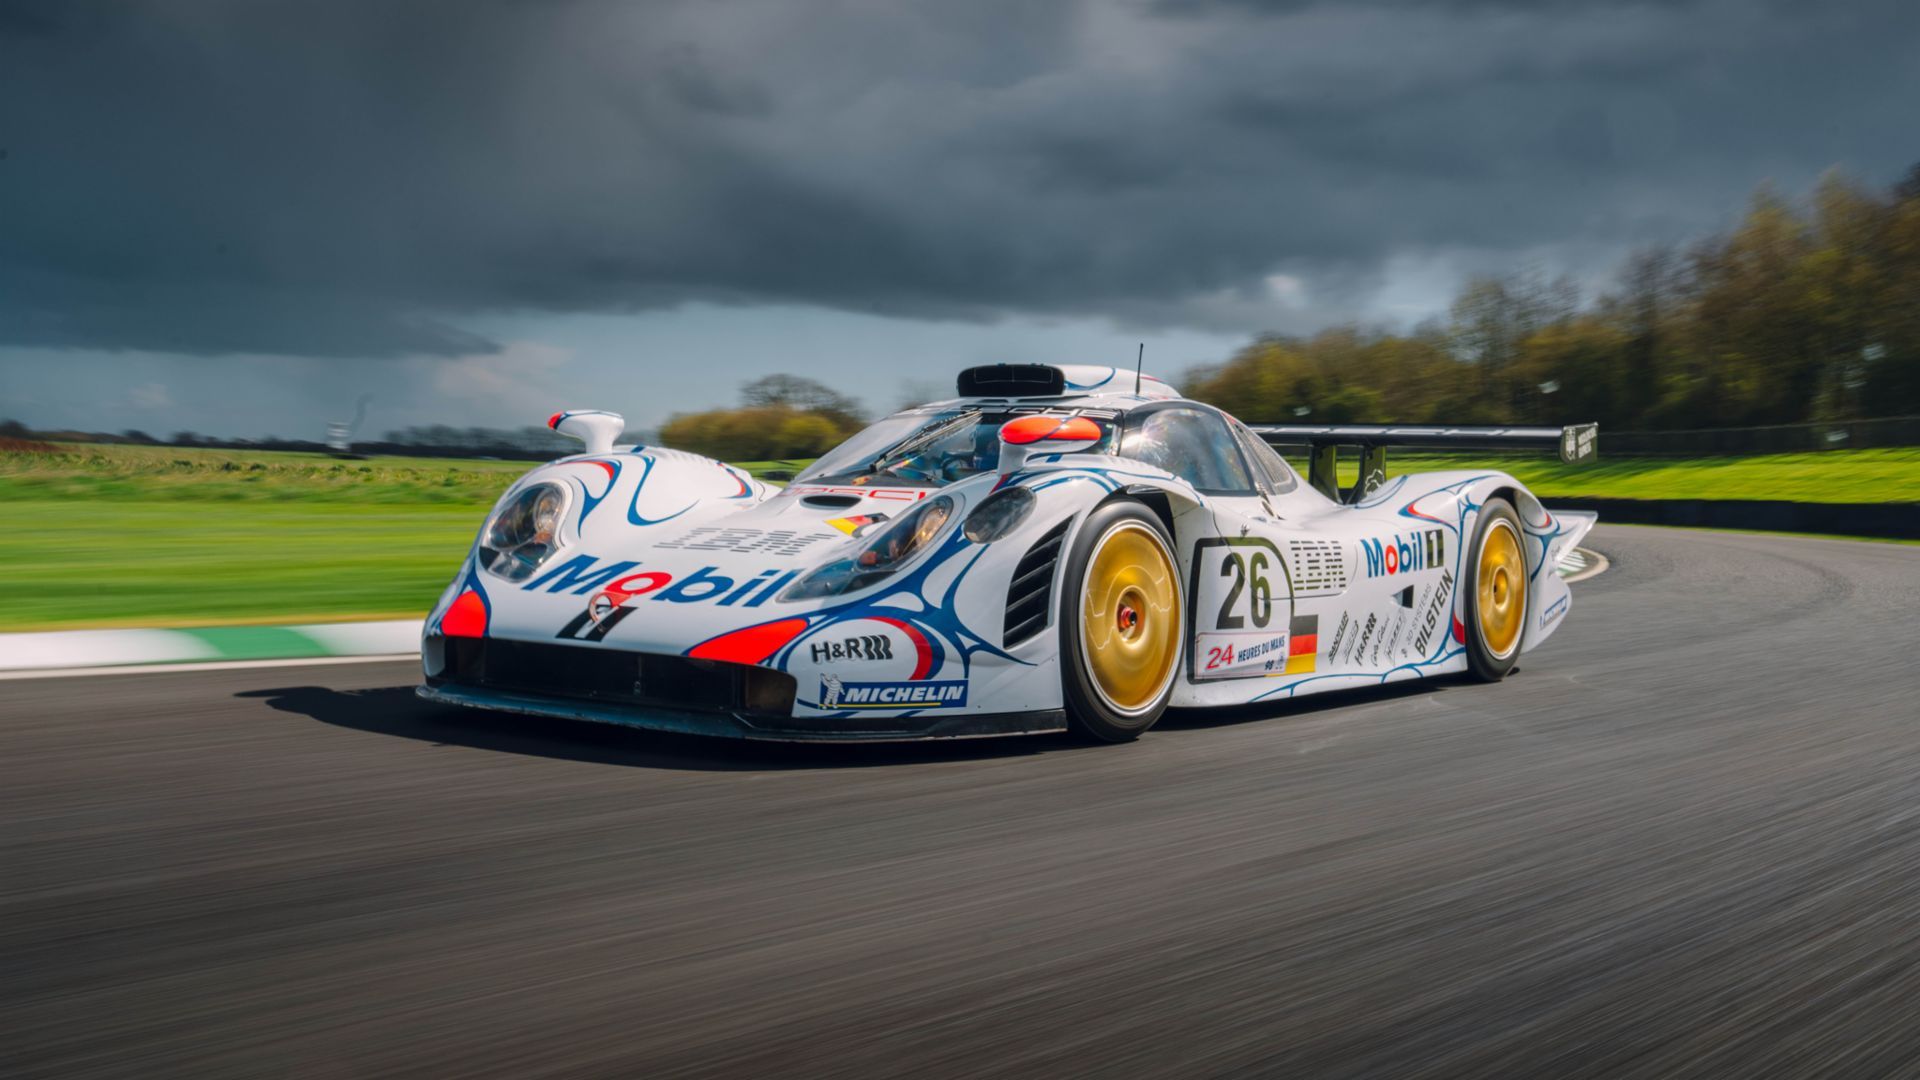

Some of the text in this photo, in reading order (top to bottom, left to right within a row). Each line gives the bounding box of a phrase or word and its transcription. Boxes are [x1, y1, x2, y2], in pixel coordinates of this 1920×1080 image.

[652, 528, 838, 556] IBM
[1290, 540, 1346, 591] IBM
[1360, 530, 1441, 578] Mobil 1
[521, 554, 805, 607] Mobil
[1216, 552, 1271, 630] 26
[1415, 568, 1453, 658] BILSTEIN
[811, 638, 861, 663] H&R
[1206, 635, 1285, 670] 24 HEURES DU MANS
[844, 685, 964, 703] MICHELIN
